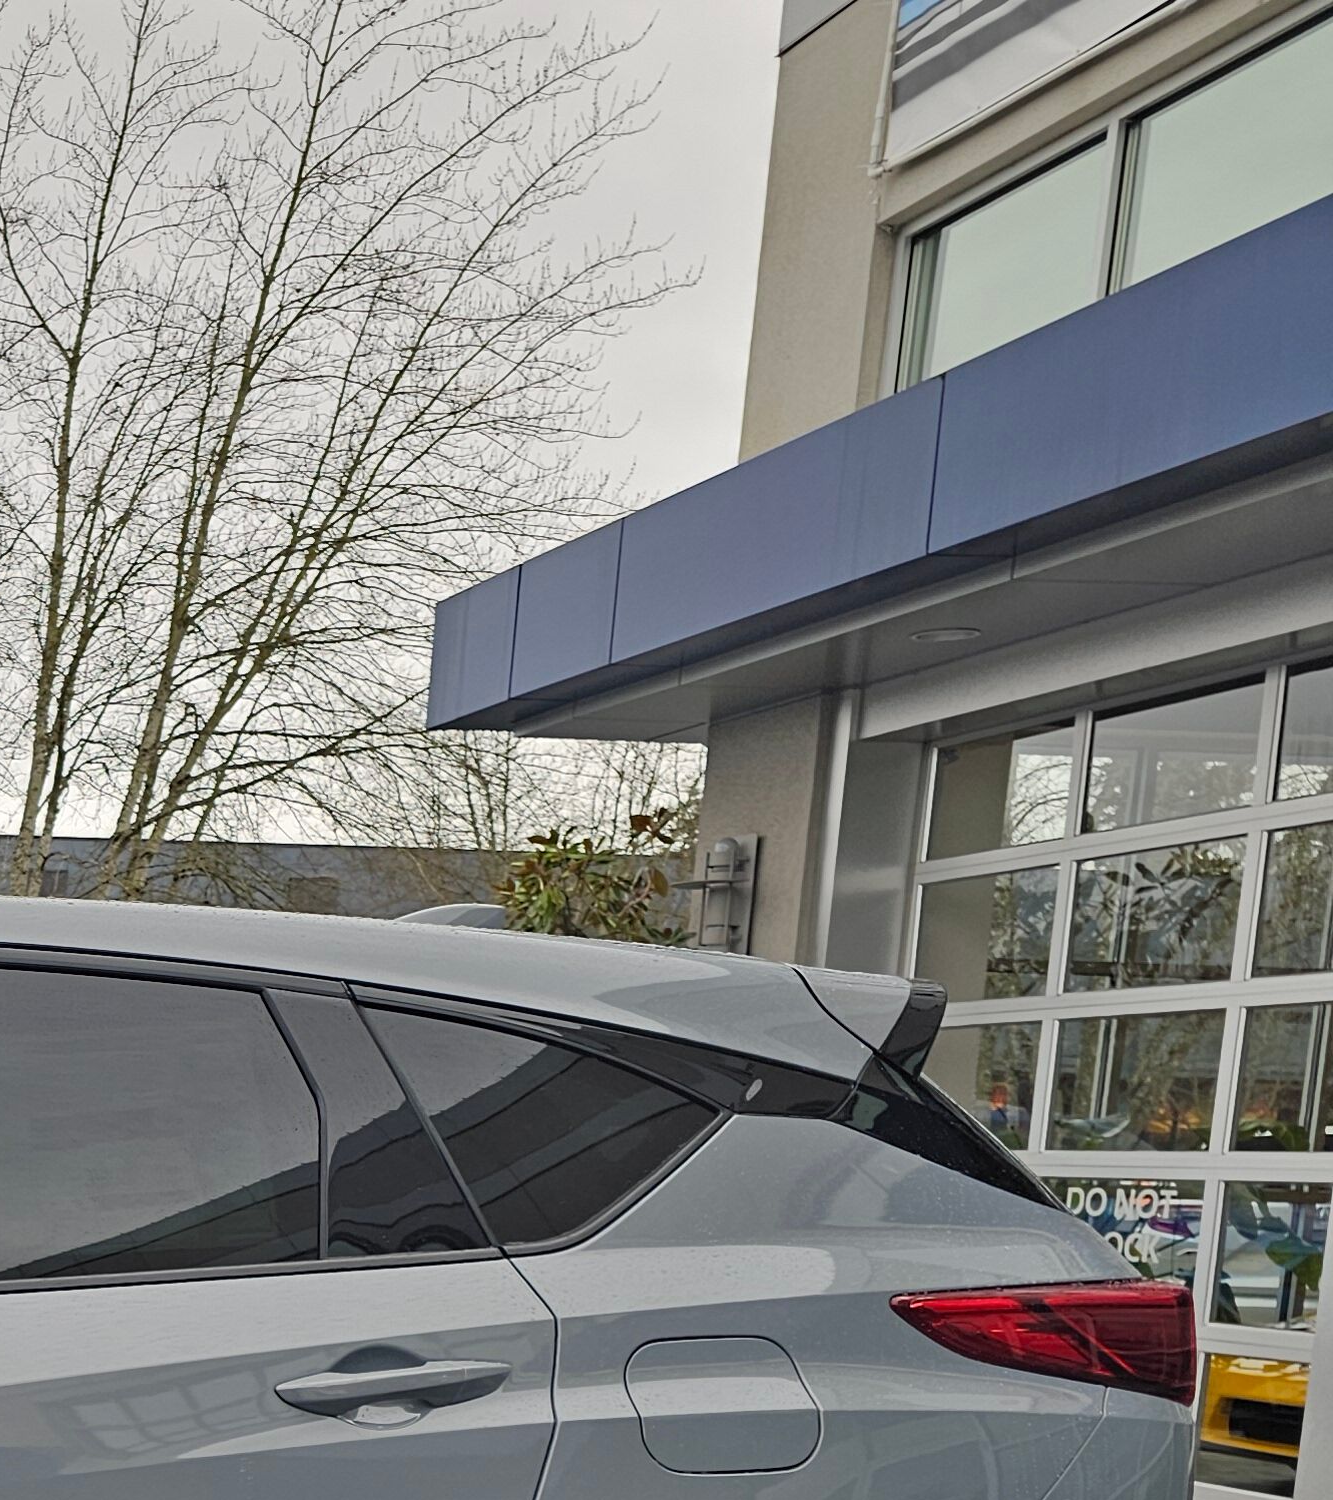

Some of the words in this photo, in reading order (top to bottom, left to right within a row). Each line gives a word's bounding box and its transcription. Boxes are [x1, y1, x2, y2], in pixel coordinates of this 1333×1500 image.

[1066, 1187, 1107, 1217] DO
[1114, 1188, 1178, 1221] NOT
[1104, 1231, 1159, 1264] OCK
